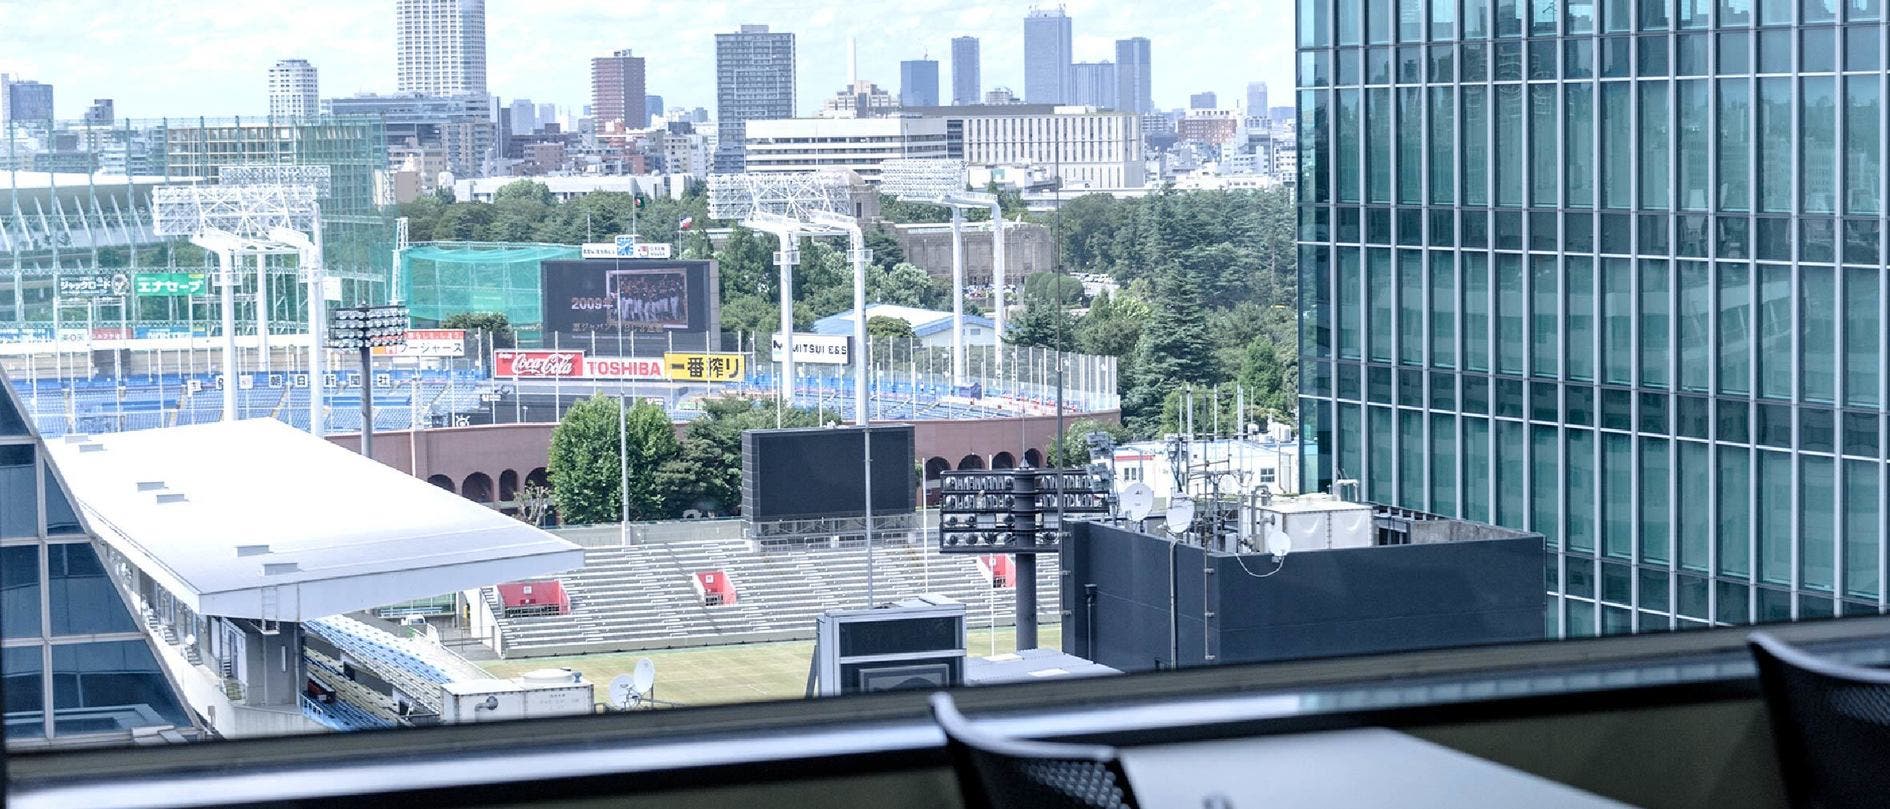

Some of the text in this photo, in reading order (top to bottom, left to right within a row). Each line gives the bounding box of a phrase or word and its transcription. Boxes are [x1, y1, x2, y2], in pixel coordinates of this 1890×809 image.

[137, 280, 204, 293] エナセーブ
[587, 361, 661, 376] TOSHIBA
[671, 357, 739, 379] 一番搾り
